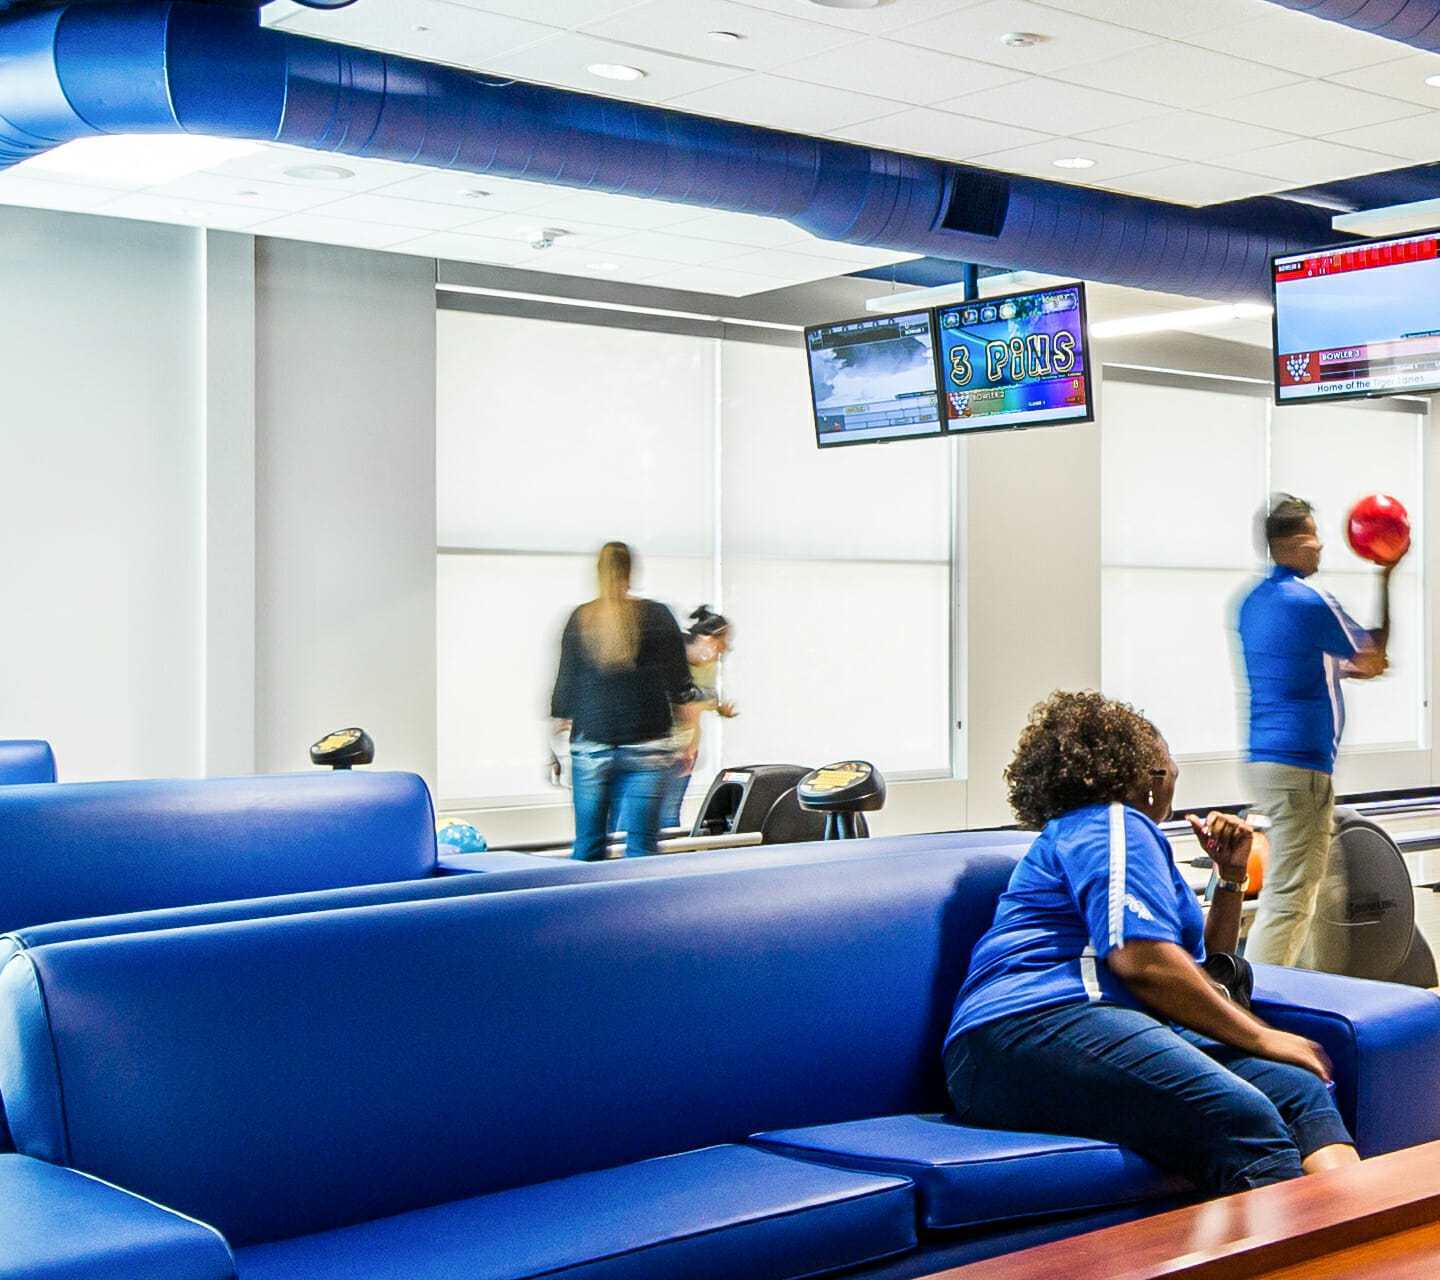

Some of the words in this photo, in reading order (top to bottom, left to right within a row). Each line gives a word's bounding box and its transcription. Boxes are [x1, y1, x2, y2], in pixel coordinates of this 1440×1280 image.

[1322, 350, 1353, 361] BOWLER
[950, 345, 973, 386] 3
[1317, 382, 1343, 393] Home
[1345, 381, 1355, 390] of
[1356, 380, 1371, 389] the
